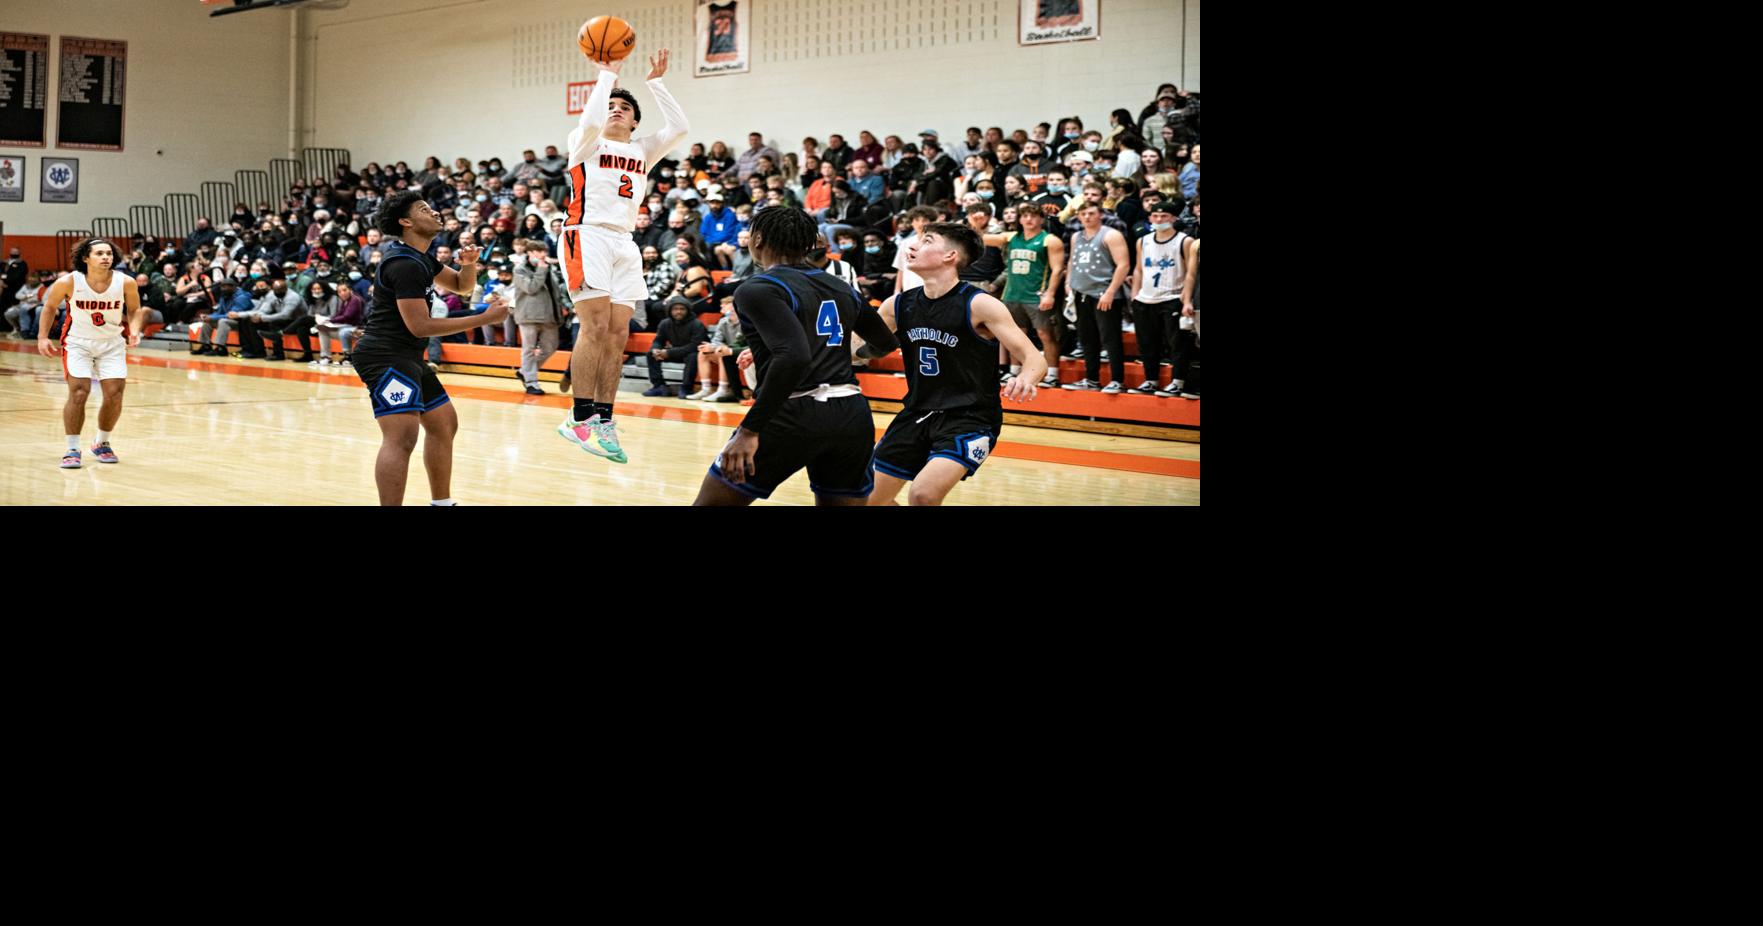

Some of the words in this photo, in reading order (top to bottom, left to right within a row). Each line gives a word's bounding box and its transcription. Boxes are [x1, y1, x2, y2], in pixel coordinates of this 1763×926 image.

[618, 174, 633, 199] 2
[1078, 251, 1091, 264] 21
[1152, 272, 1161, 288] 1
[75, 300, 121, 310] MIDDLE
[816, 300, 844, 347] 4
[919, 346, 940, 377] 5
